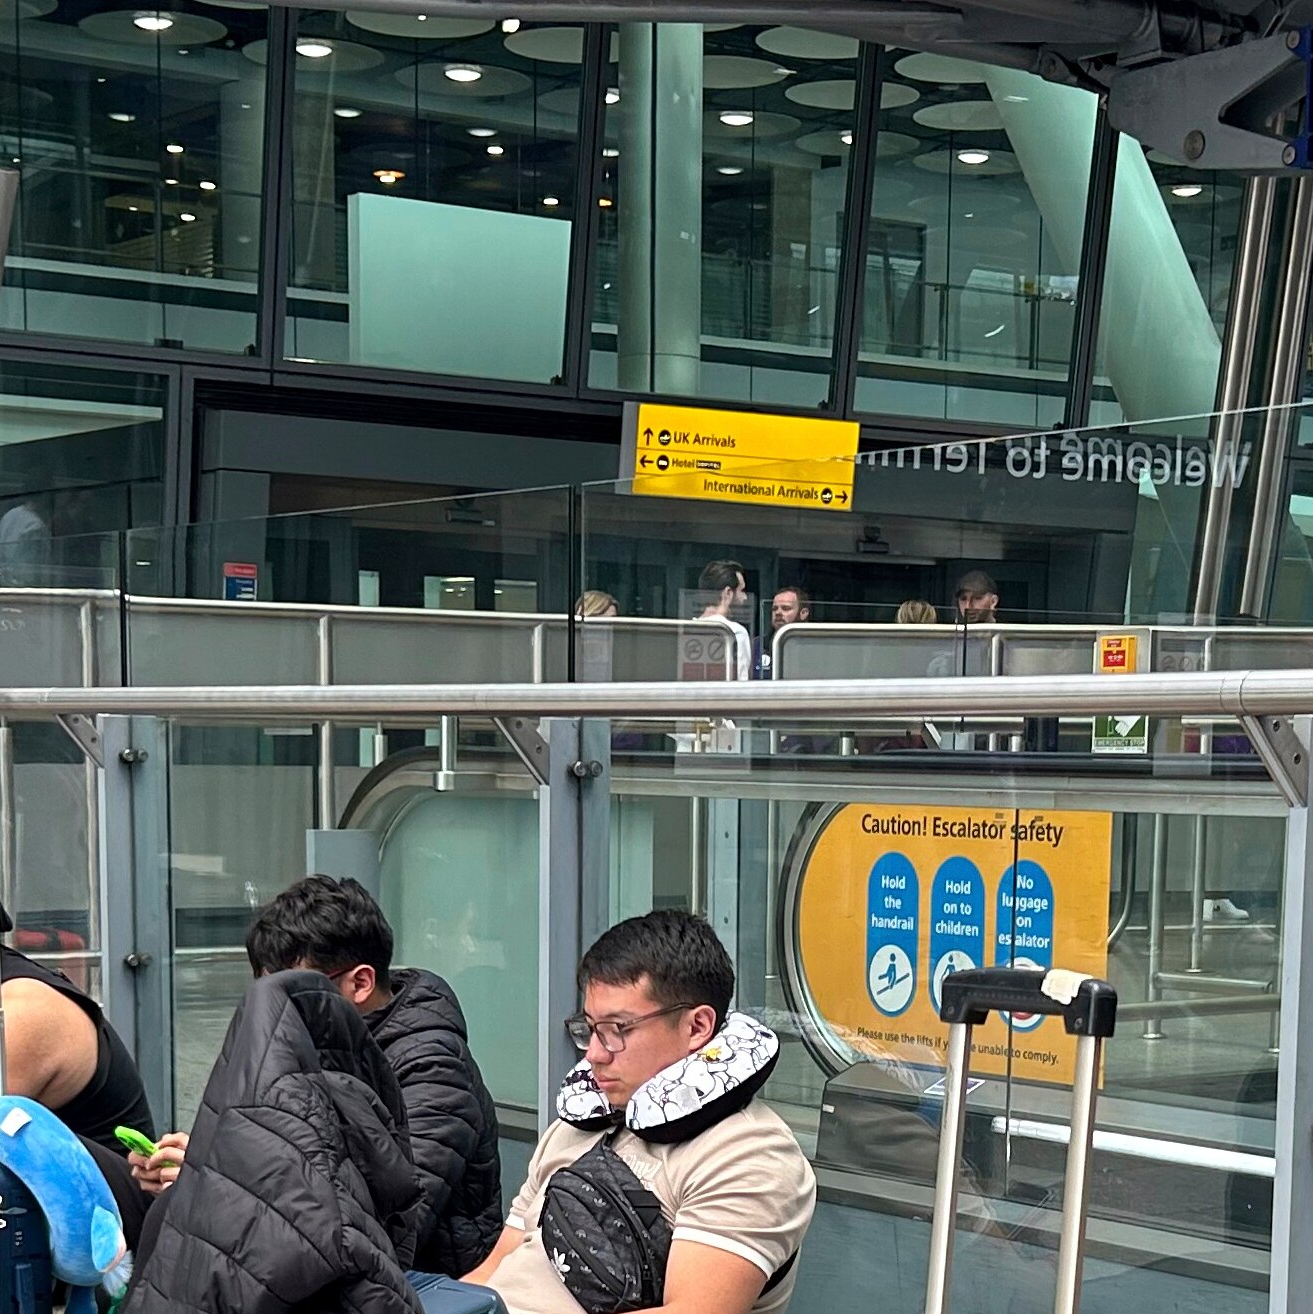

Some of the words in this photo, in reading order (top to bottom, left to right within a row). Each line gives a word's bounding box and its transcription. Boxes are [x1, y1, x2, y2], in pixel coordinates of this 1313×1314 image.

[674, 430, 690, 445] UK
[693, 433, 736, 448] Arrivals
[672, 458, 696, 468] Hotel
[703, 479, 775, 496] International
[778, 486, 819, 500] Arrivals
[862, 814, 928, 836] Caution!
[932, 816, 1006, 840] Escalator
[1010, 820, 1064, 848] safety
[882, 875, 906, 890] Hold
[946, 880, 971, 894] Hold
[1016, 875, 1034, 890] No
[884, 895, 902, 910] the
[944, 902, 958, 914] on
[960, 902, 972, 916] to
[872, 913, 914, 930] handrail
[936, 920, 979, 936] children
[1016, 916, 1032, 928] on
[998, 932, 1050, 948] esalator
[858, 1027, 882, 1040] Please
[884, 1032, 900, 1042] use
[901, 1032, 916, 1044] the
[916, 1034, 933, 1047] lifts
[934, 1036, 942, 1048] if
[1022, 1050, 1059, 1065] comply.
